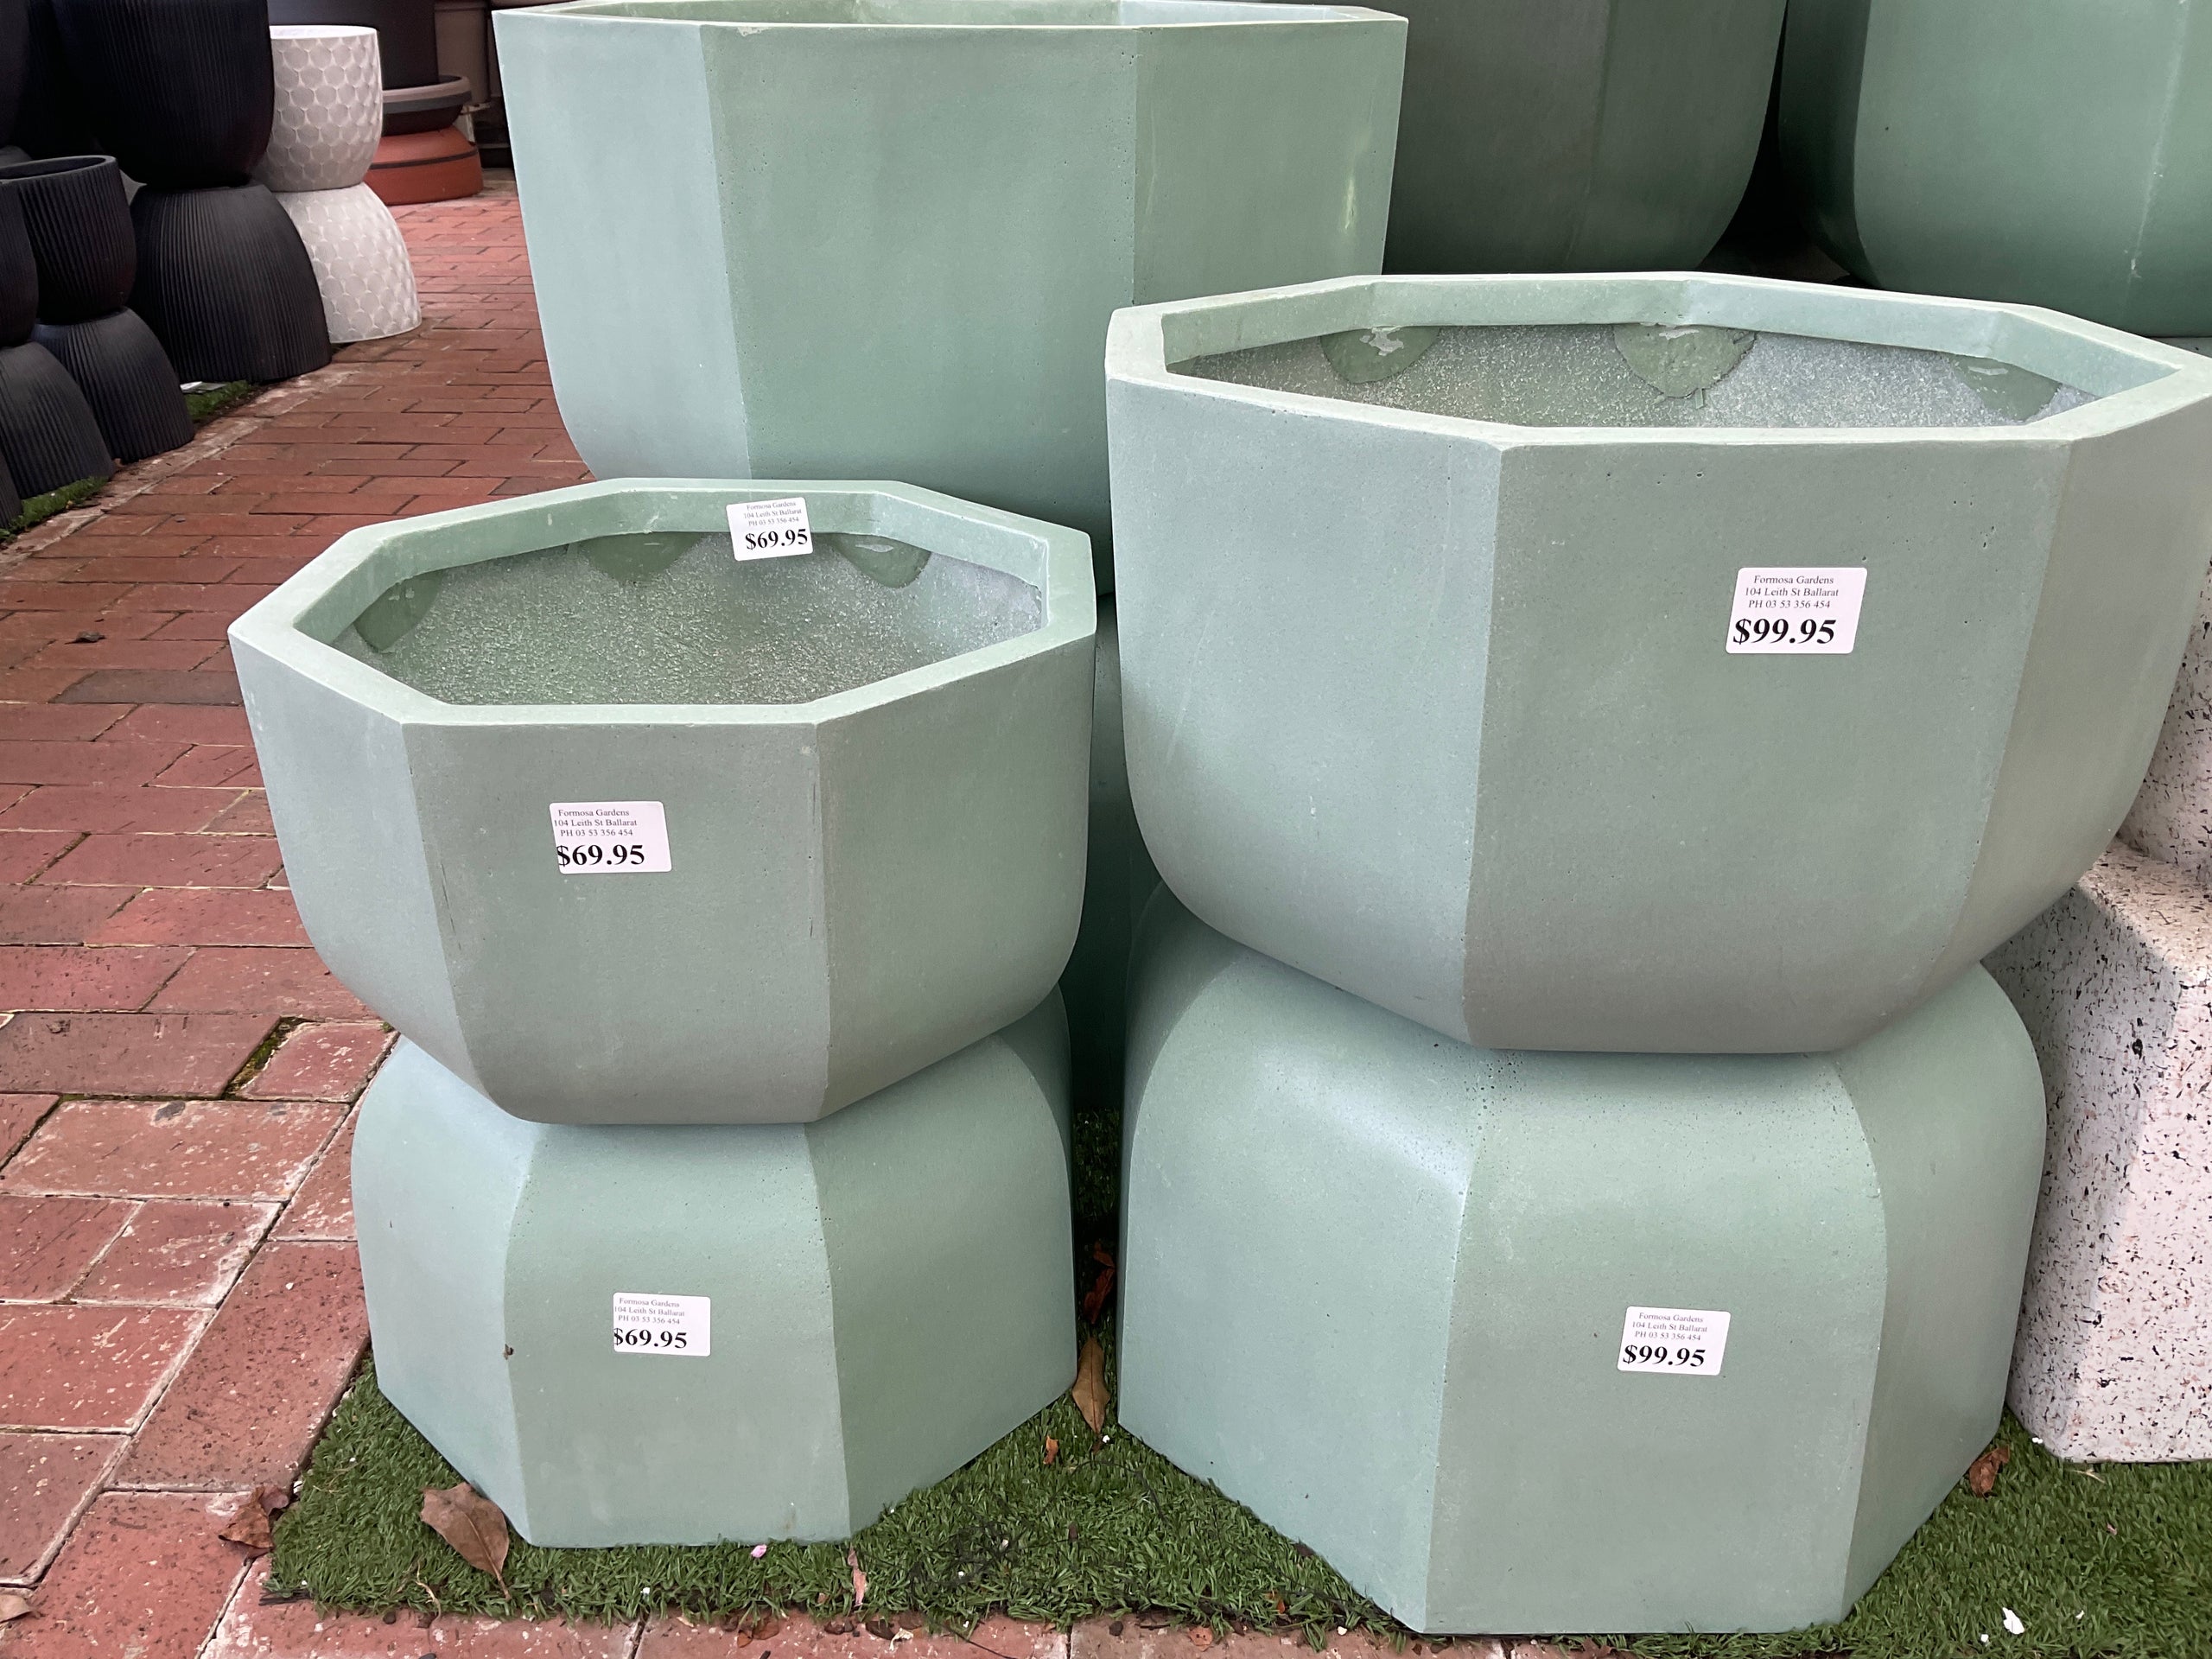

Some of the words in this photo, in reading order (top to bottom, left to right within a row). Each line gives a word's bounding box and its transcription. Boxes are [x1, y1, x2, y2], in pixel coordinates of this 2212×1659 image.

[745, 529, 807, 550] $69.95
[1754, 575, 1794, 584] Formosa
[1796, 575, 1834, 584] Gardens
[1764, 588, 1788, 596] Leith
[1790, 588, 1800, 596] St
[1803, 588, 1839, 597] Ballarat
[1732, 618, 1836, 645] $99.95
[556, 844, 645, 867] $69.95
[1639, 1313, 1671, 1321] Formosa
[614, 1328, 687, 1349] $69.95
[1623, 1344, 1706, 1367] $99.95
